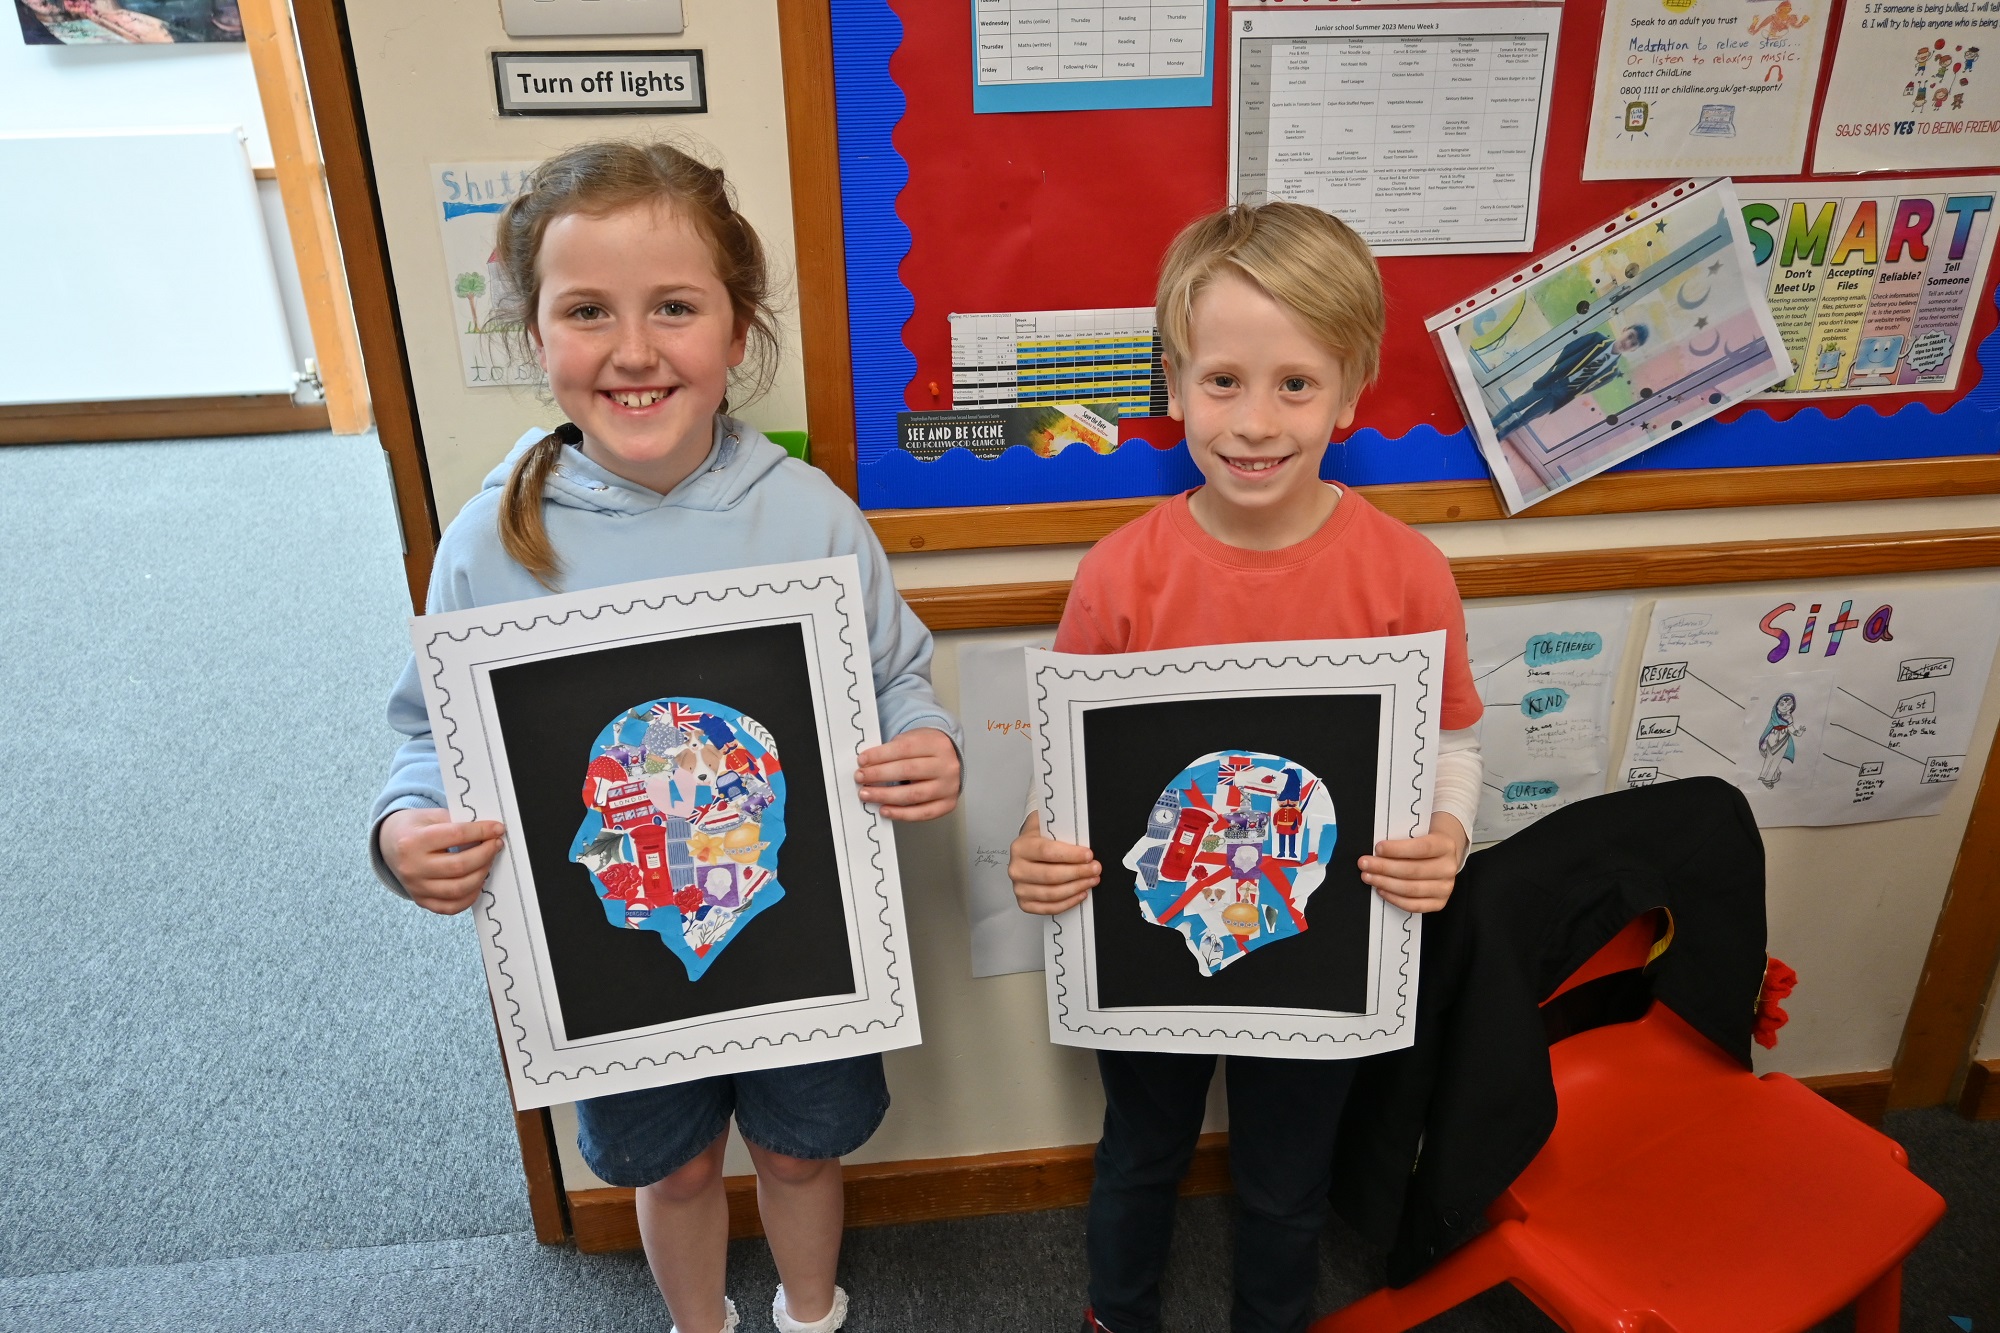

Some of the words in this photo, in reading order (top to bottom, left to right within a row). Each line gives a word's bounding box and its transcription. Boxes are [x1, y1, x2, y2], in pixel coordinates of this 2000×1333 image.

[1874, 4, 1882, 13] If
[1883, 5, 1914, 13] someone
[1917, 4, 1923, 12] is
[1925, 4, 1944, 14] being
[1971, 3, 1976, 12] I
[1977, 2, 1989, 12] will
[1631, 18, 1655, 28] Speak
[1679, 17, 1700, 25] adult
[1702, 17, 1716, 27] you
[1718, 16, 1738, 25] trust
[1870, 19, 1876, 28] I
[1877, 18, 1888, 28] will
[1890, 19, 1901, 30] try
[1902, 19, 1909, 27] to
[1911, 18, 1926, 30] help
[1928, 21, 1952, 29] anyone
[1954, 17, 1969, 27] who
[1971, 19, 1978, 27] is
[1979, 18, 1999, 29] being
[1697, 37, 1708, 51] to
[1717, 38, 1749, 49] relieve
[1627, 55, 1642, 66] Or
[1652, 55, 1683, 65] listen
[1692, 56, 1704, 65] to
[1713, 53, 1753, 69] relaxing
[1622, 70, 1653, 78] Contact
[1656, 69, 1692, 77] ChildLine
[517, 73, 573, 93] Turn
[581, 71, 613, 92] off
[620, 70, 685, 97] lights
[1620, 86, 1641, 95] 0800
[1644, 86, 1659, 94] 1111
[1672, 83, 1782, 95] childline.org.uk/get-support/
[1835, 124, 1862, 137] SGJS
[1864, 123, 1890, 136] SAYS
[1893, 121, 1916, 135] YES
[1917, 122, 1930, 134] TO
[1932, 121, 1963, 134] BEING
[1741, 195, 1993, 267] SMART
[1827, 268, 1874, 279] Accepting
[1943, 262, 1960, 273] Tell
[1785, 269, 1812, 279] Don't
[1879, 271, 1921, 283] Reliable?
[1837, 282, 1858, 290] Files
[1927, 277, 1969, 286] Someone
[1774, 284, 1799, 294] Meet
[1802, 283, 1815, 293] Up
[1082, 411, 1091, 420] Save
[907, 427, 924, 441] SEE
[928, 426, 951, 440] AND
[955, 426, 968, 439] BE
[972, 425, 1003, 439] SCENE
[906, 441, 921, 449] OLD
[923, 440, 971, 448] HOLLYWOOD
[972, 439, 1006, 447] GLAMOUR
[1759, 600, 1893, 663] Sita
[1642, 666, 1685, 682] RESPECT
[1528, 694, 1563, 715] KIND
[1891, 719, 1904, 728] She
[1909, 728, 1917, 736] to
[614, 794, 648, 806] LONDON
